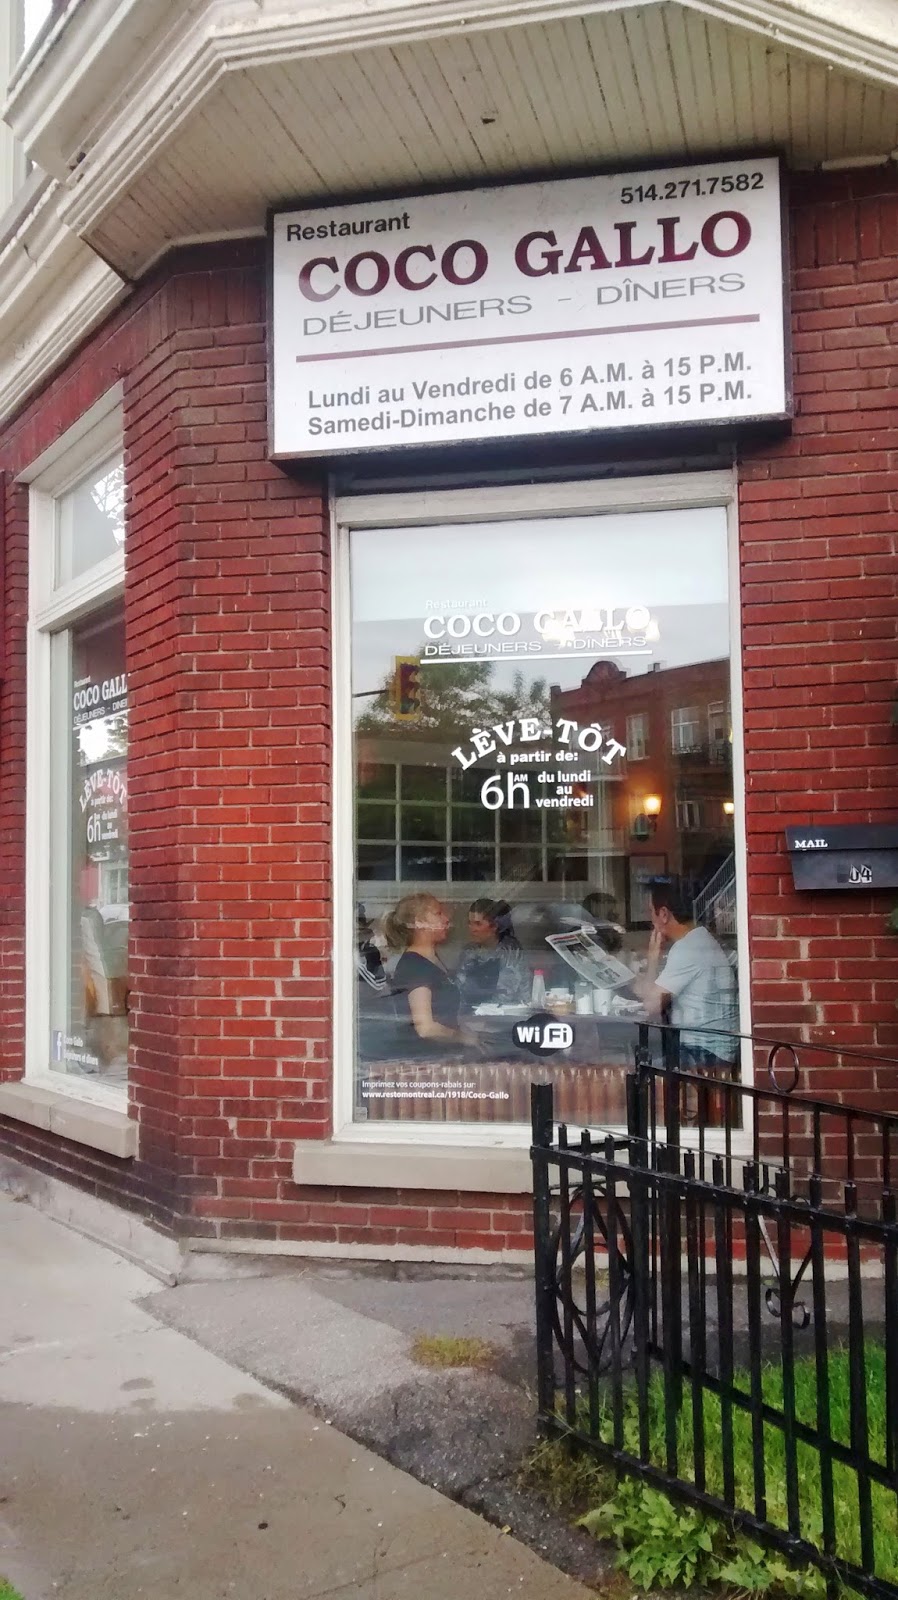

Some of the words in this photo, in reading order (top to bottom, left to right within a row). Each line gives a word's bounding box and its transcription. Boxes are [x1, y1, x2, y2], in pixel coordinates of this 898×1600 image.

[620, 172, 765, 205] 514.271.7582
[286, 212, 411, 242] Restaurant
[298, 239, 489, 303] COCO
[513, 210, 752, 278] GALLO
[303, 295, 532, 336] DÉJEUNERS
[596, 272, 745, 306] DÎNERS
[307, 384, 371, 409] Lundi
[377, 385, 405, 404] au
[412, 372, 516, 401] Vendredi
[523, 369, 552, 391] de
[559, 366, 573, 388] 6
[580, 361, 633, 386] A.M.
[641, 359, 655, 380] à
[663, 356, 691, 377] 15
[700, 351, 752, 374] P.M.
[307, 402, 516, 436] Samedi-Dimanche
[523, 397, 552, 418] de
[559, 394, 573, 415] 7
[580, 389, 633, 414] A.M.
[641, 388, 655, 408] à
[663, 384, 691, 406] 15
[700, 379, 753, 403] P.M.
[425, 599, 488, 610] Restaurant
[423, 611, 521, 639] COCO
[424, 641, 542, 656] DÉJEUNERS
[572, 636, 647, 649] DÎNERS
[74, 685, 99, 710] COCO
[102, 674, 127, 700] GALL
[451, 717, 626, 770] LÈVE-TÔT
[496, 752, 506, 764] à
[510, 751, 551, 766] partir
[555, 750, 579, 762] de:
[537, 771, 555, 783] du
[557, 770, 591, 782] lundi
[556, 785, 573, 795] au
[480, 772, 530, 810] 6h
[514, 774, 528, 782] AM
[536, 795, 594, 808] vendredi
[794, 839, 828, 849] MAIL
[362, 1081, 395, 1090] Imprimez
[409, 1080, 462, 1090] coupons-rabais
[362, 1091, 510, 1100] www.restomontreal.ca/1918/Coco-Gallo
